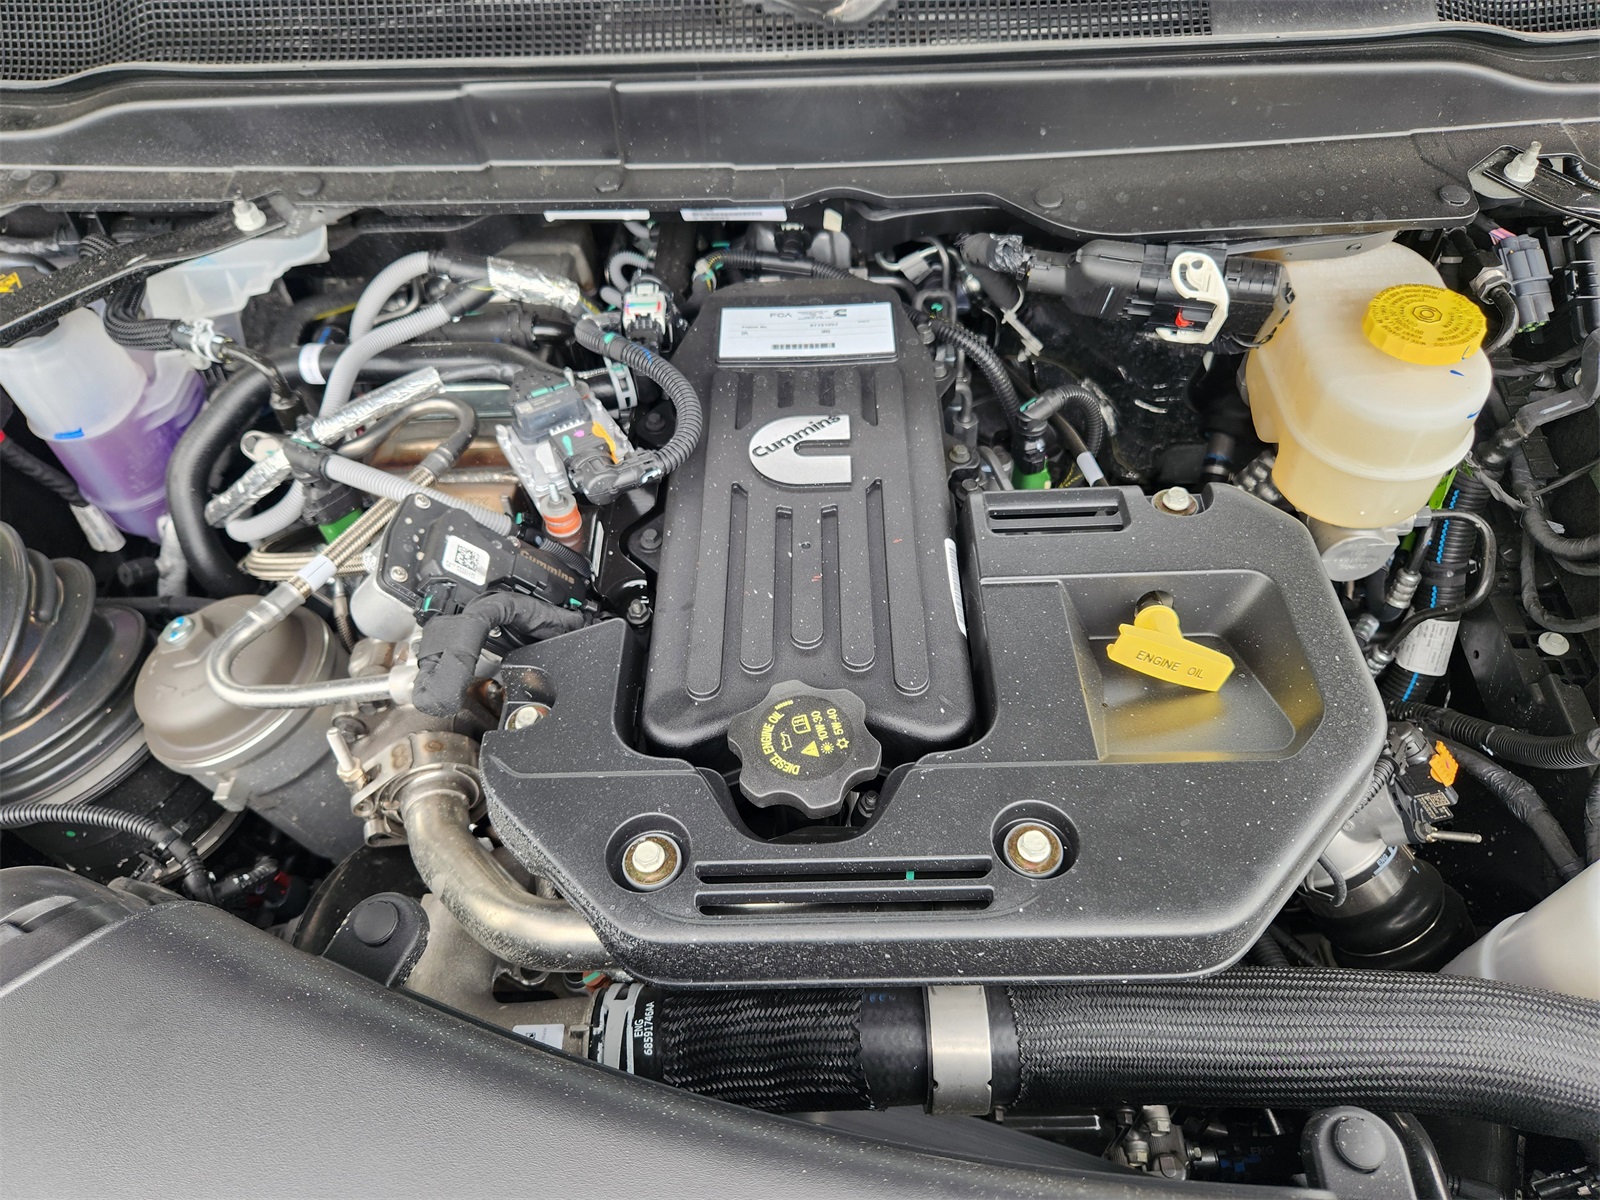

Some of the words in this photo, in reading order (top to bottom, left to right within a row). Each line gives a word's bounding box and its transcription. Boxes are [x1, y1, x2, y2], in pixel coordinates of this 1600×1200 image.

[752, 415, 841, 457] Cummins
[520, 549, 576, 584] Cummins
[1136, 650, 1181, 672] ENGINE
[1187, 666, 1204, 679] OIL
[768, 710, 785, 724] OIL
[811, 710, 829, 742] 10W-30
[826, 708, 844, 736] 5W-40
[761, 723, 775, 755] ENGINE
[769, 752, 800, 775] DIESEL
[634, 1019, 644, 1038] ENG
[643, 1001, 655, 1056] 68591746AA
